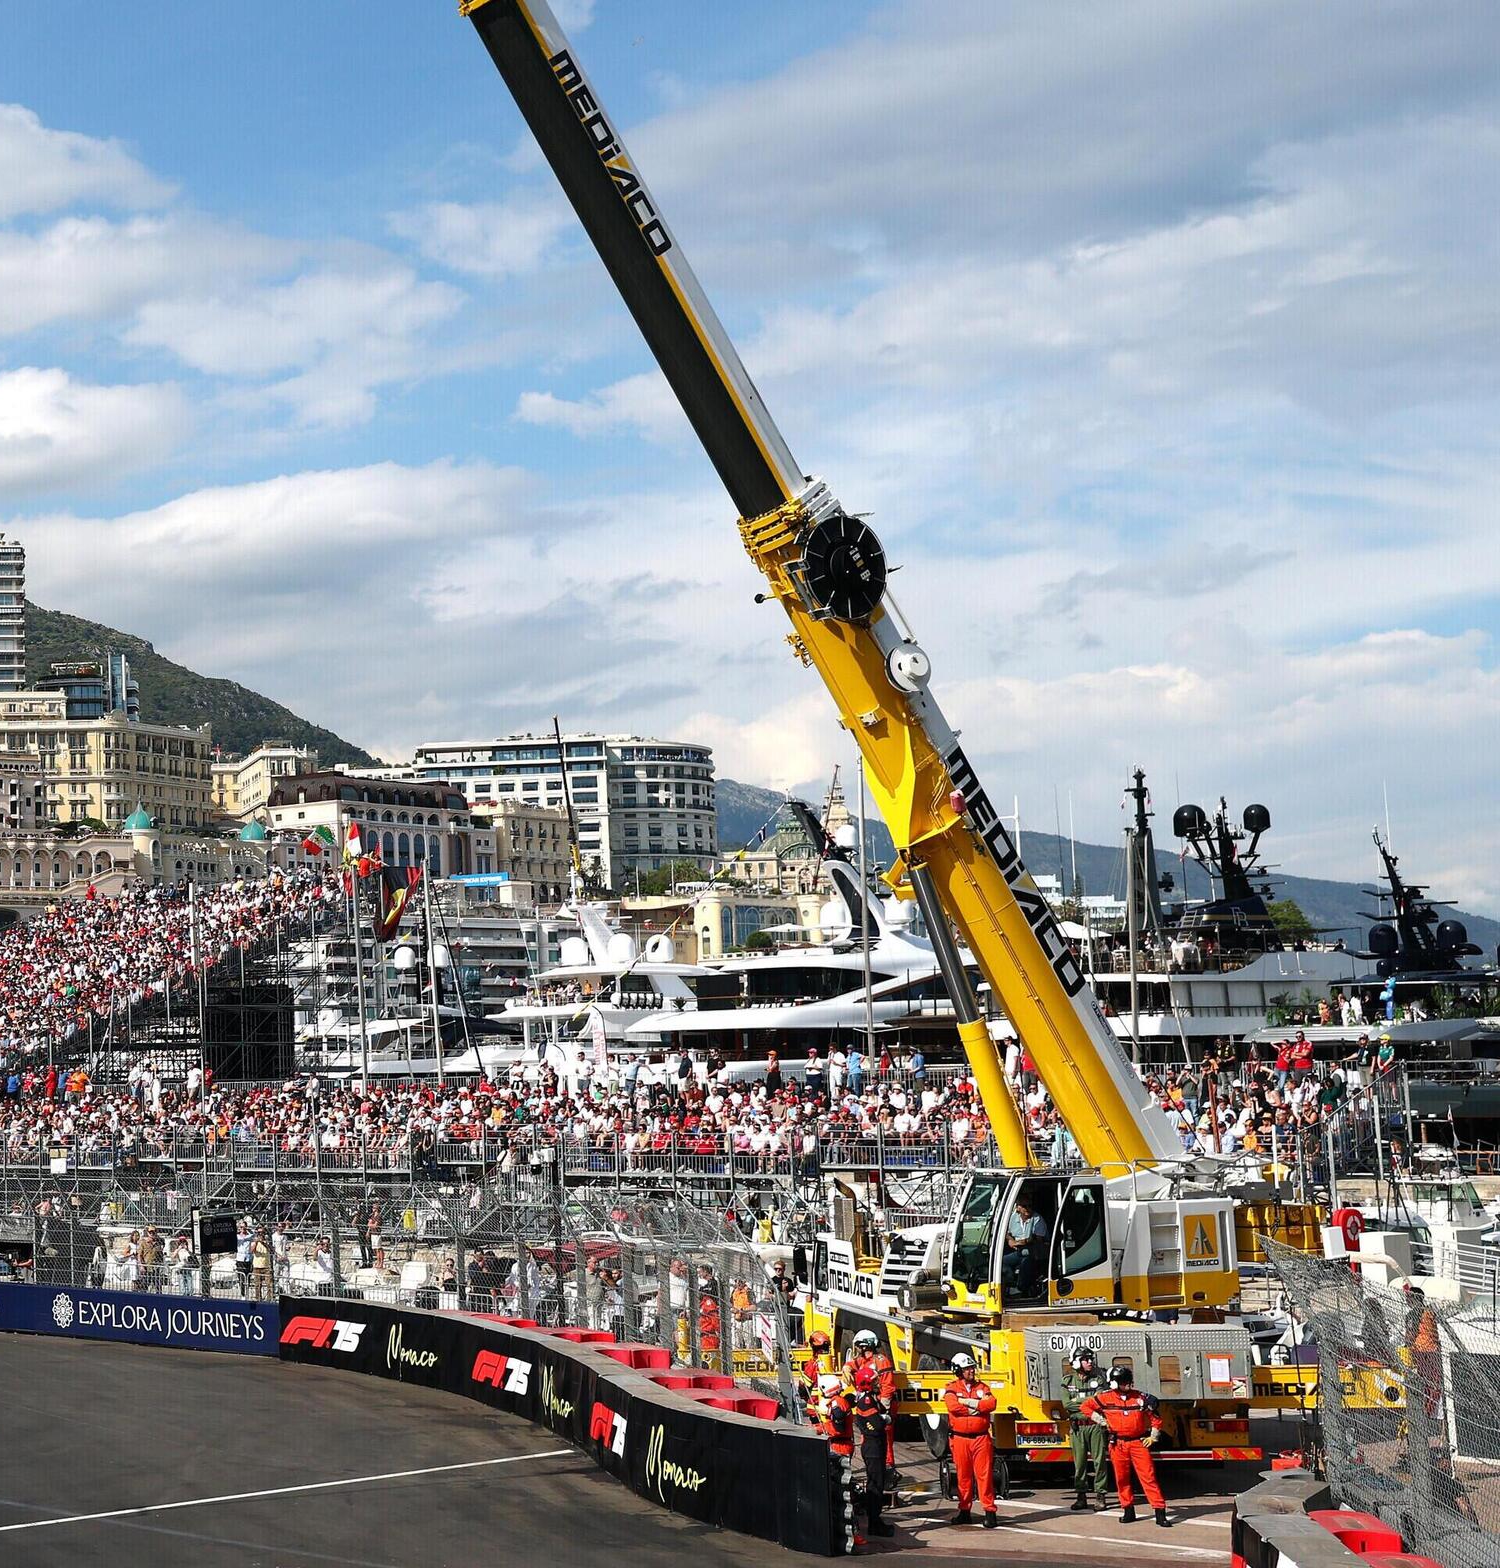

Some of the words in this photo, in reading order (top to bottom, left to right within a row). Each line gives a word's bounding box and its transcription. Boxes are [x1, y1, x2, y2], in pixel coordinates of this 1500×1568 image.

[79, 1300, 163, 1331] EXPLORA
[165, 1309, 265, 1340] JOURNEYS
[1051, 1336, 1064, 1350] 60
[1070, 1336, 1082, 1350] 70
[1089, 1335, 1102, 1350] 80
